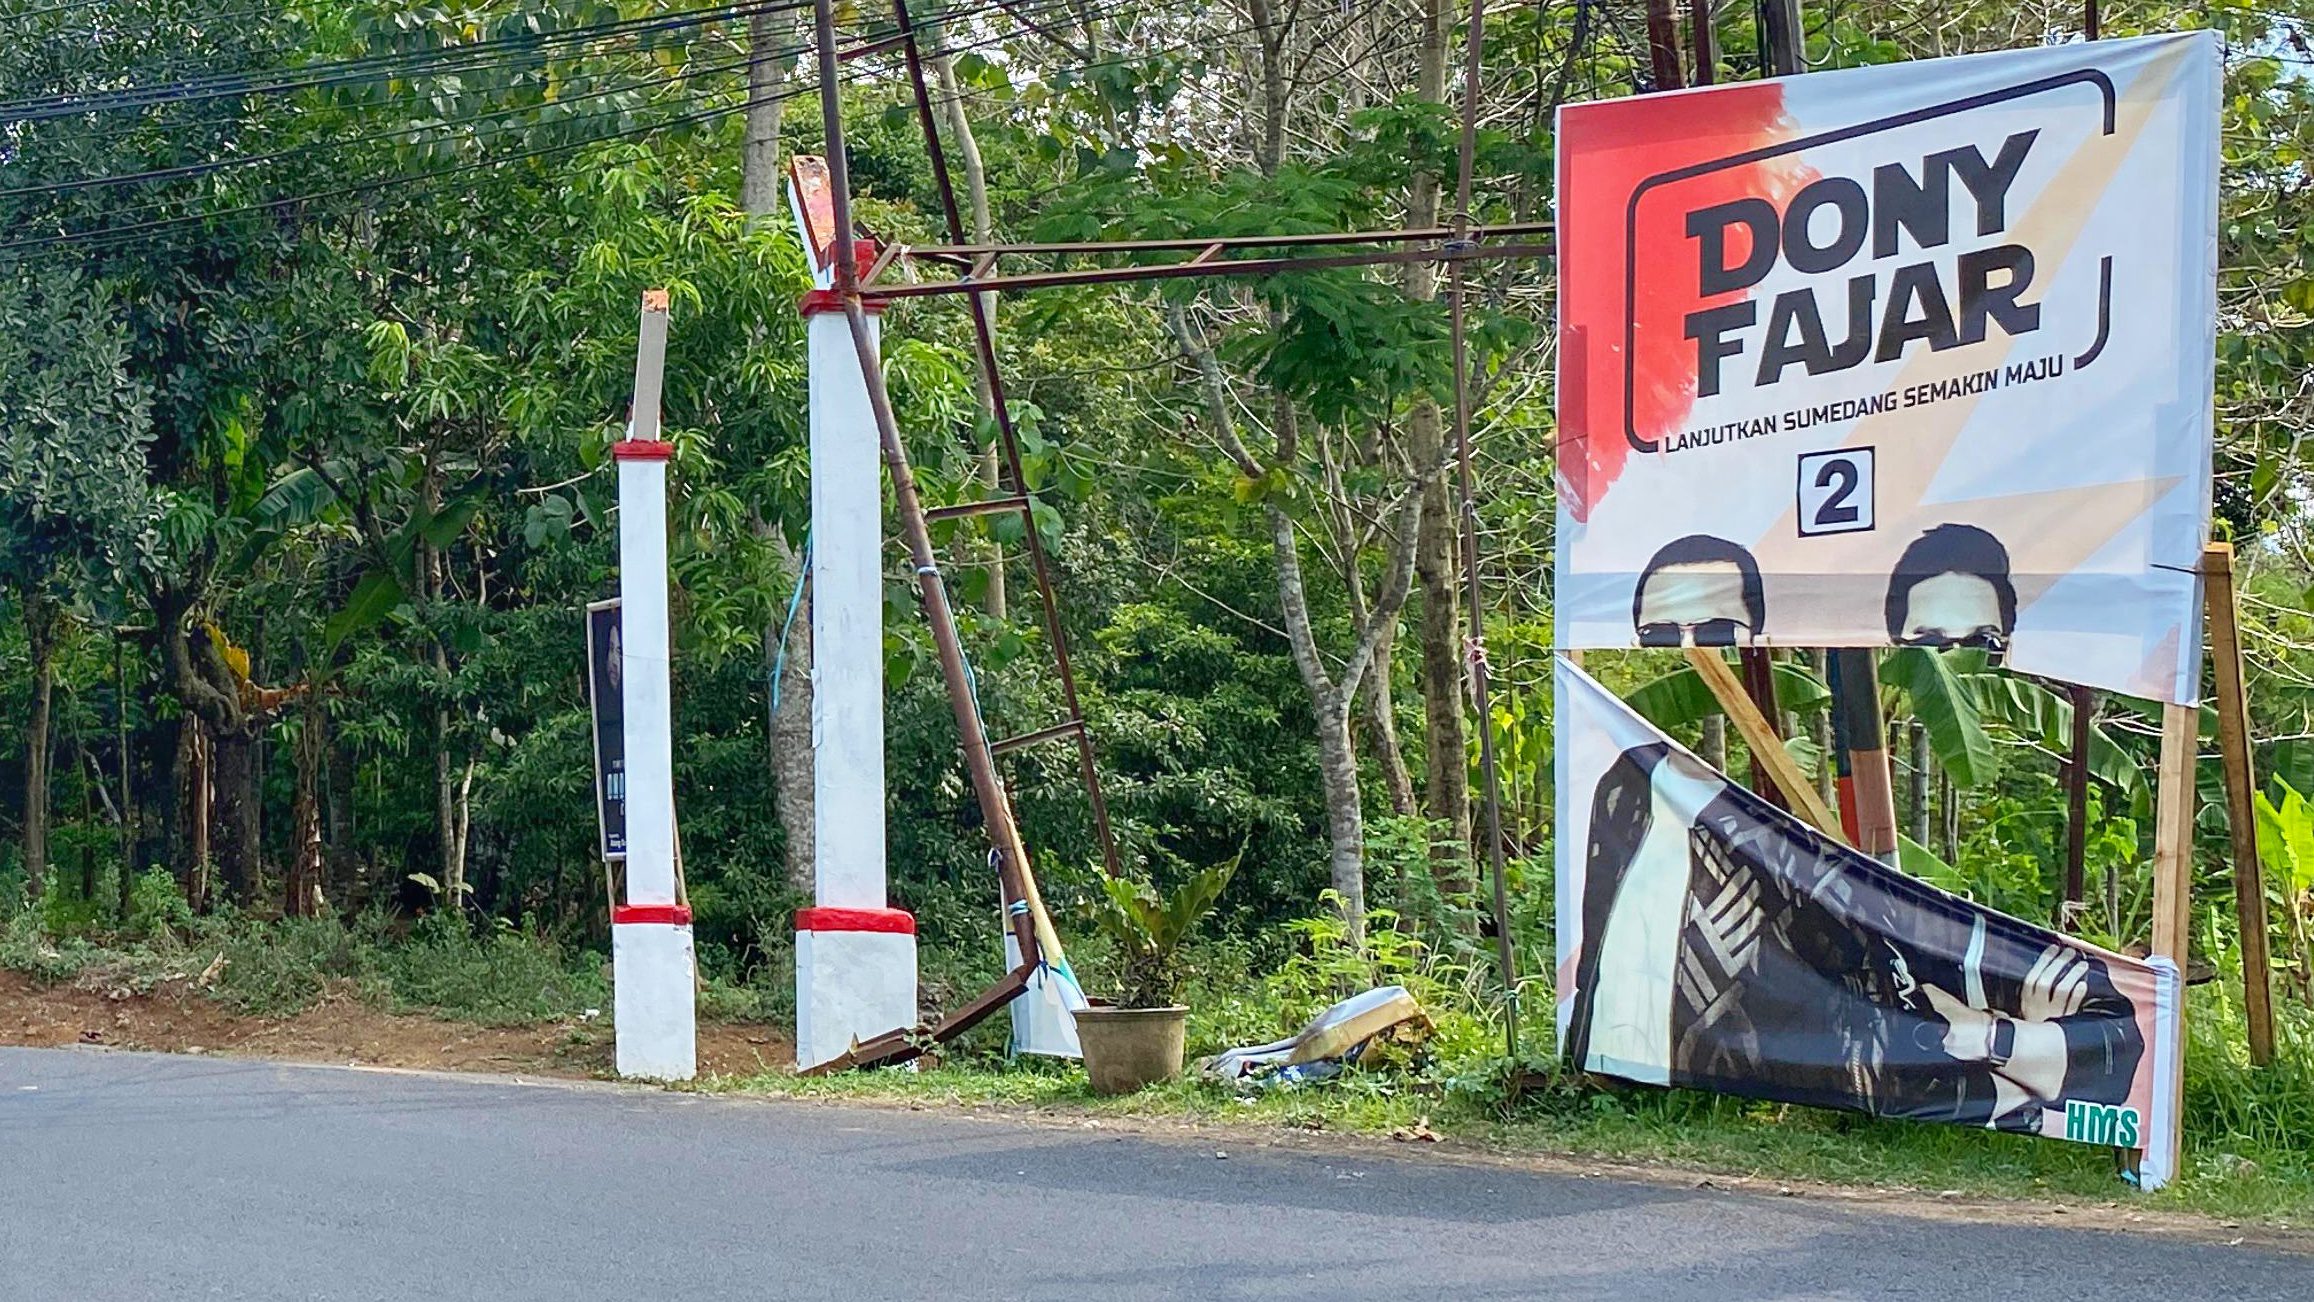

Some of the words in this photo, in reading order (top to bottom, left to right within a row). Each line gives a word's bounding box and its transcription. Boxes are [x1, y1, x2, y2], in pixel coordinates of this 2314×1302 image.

[1685, 128, 2041, 298] DONY
[1684, 243, 2040, 398] FAJAR
[1665, 416, 1777, 453] LANJUTKAN
[1783, 392, 1897, 431] SUMEDANG
[1903, 368, 1998, 408] SEMAKIN
[2005, 354, 2063, 387] MAJU
[1814, 459, 1859, 525] 2
[2066, 1102, 2138, 1147] HMS
